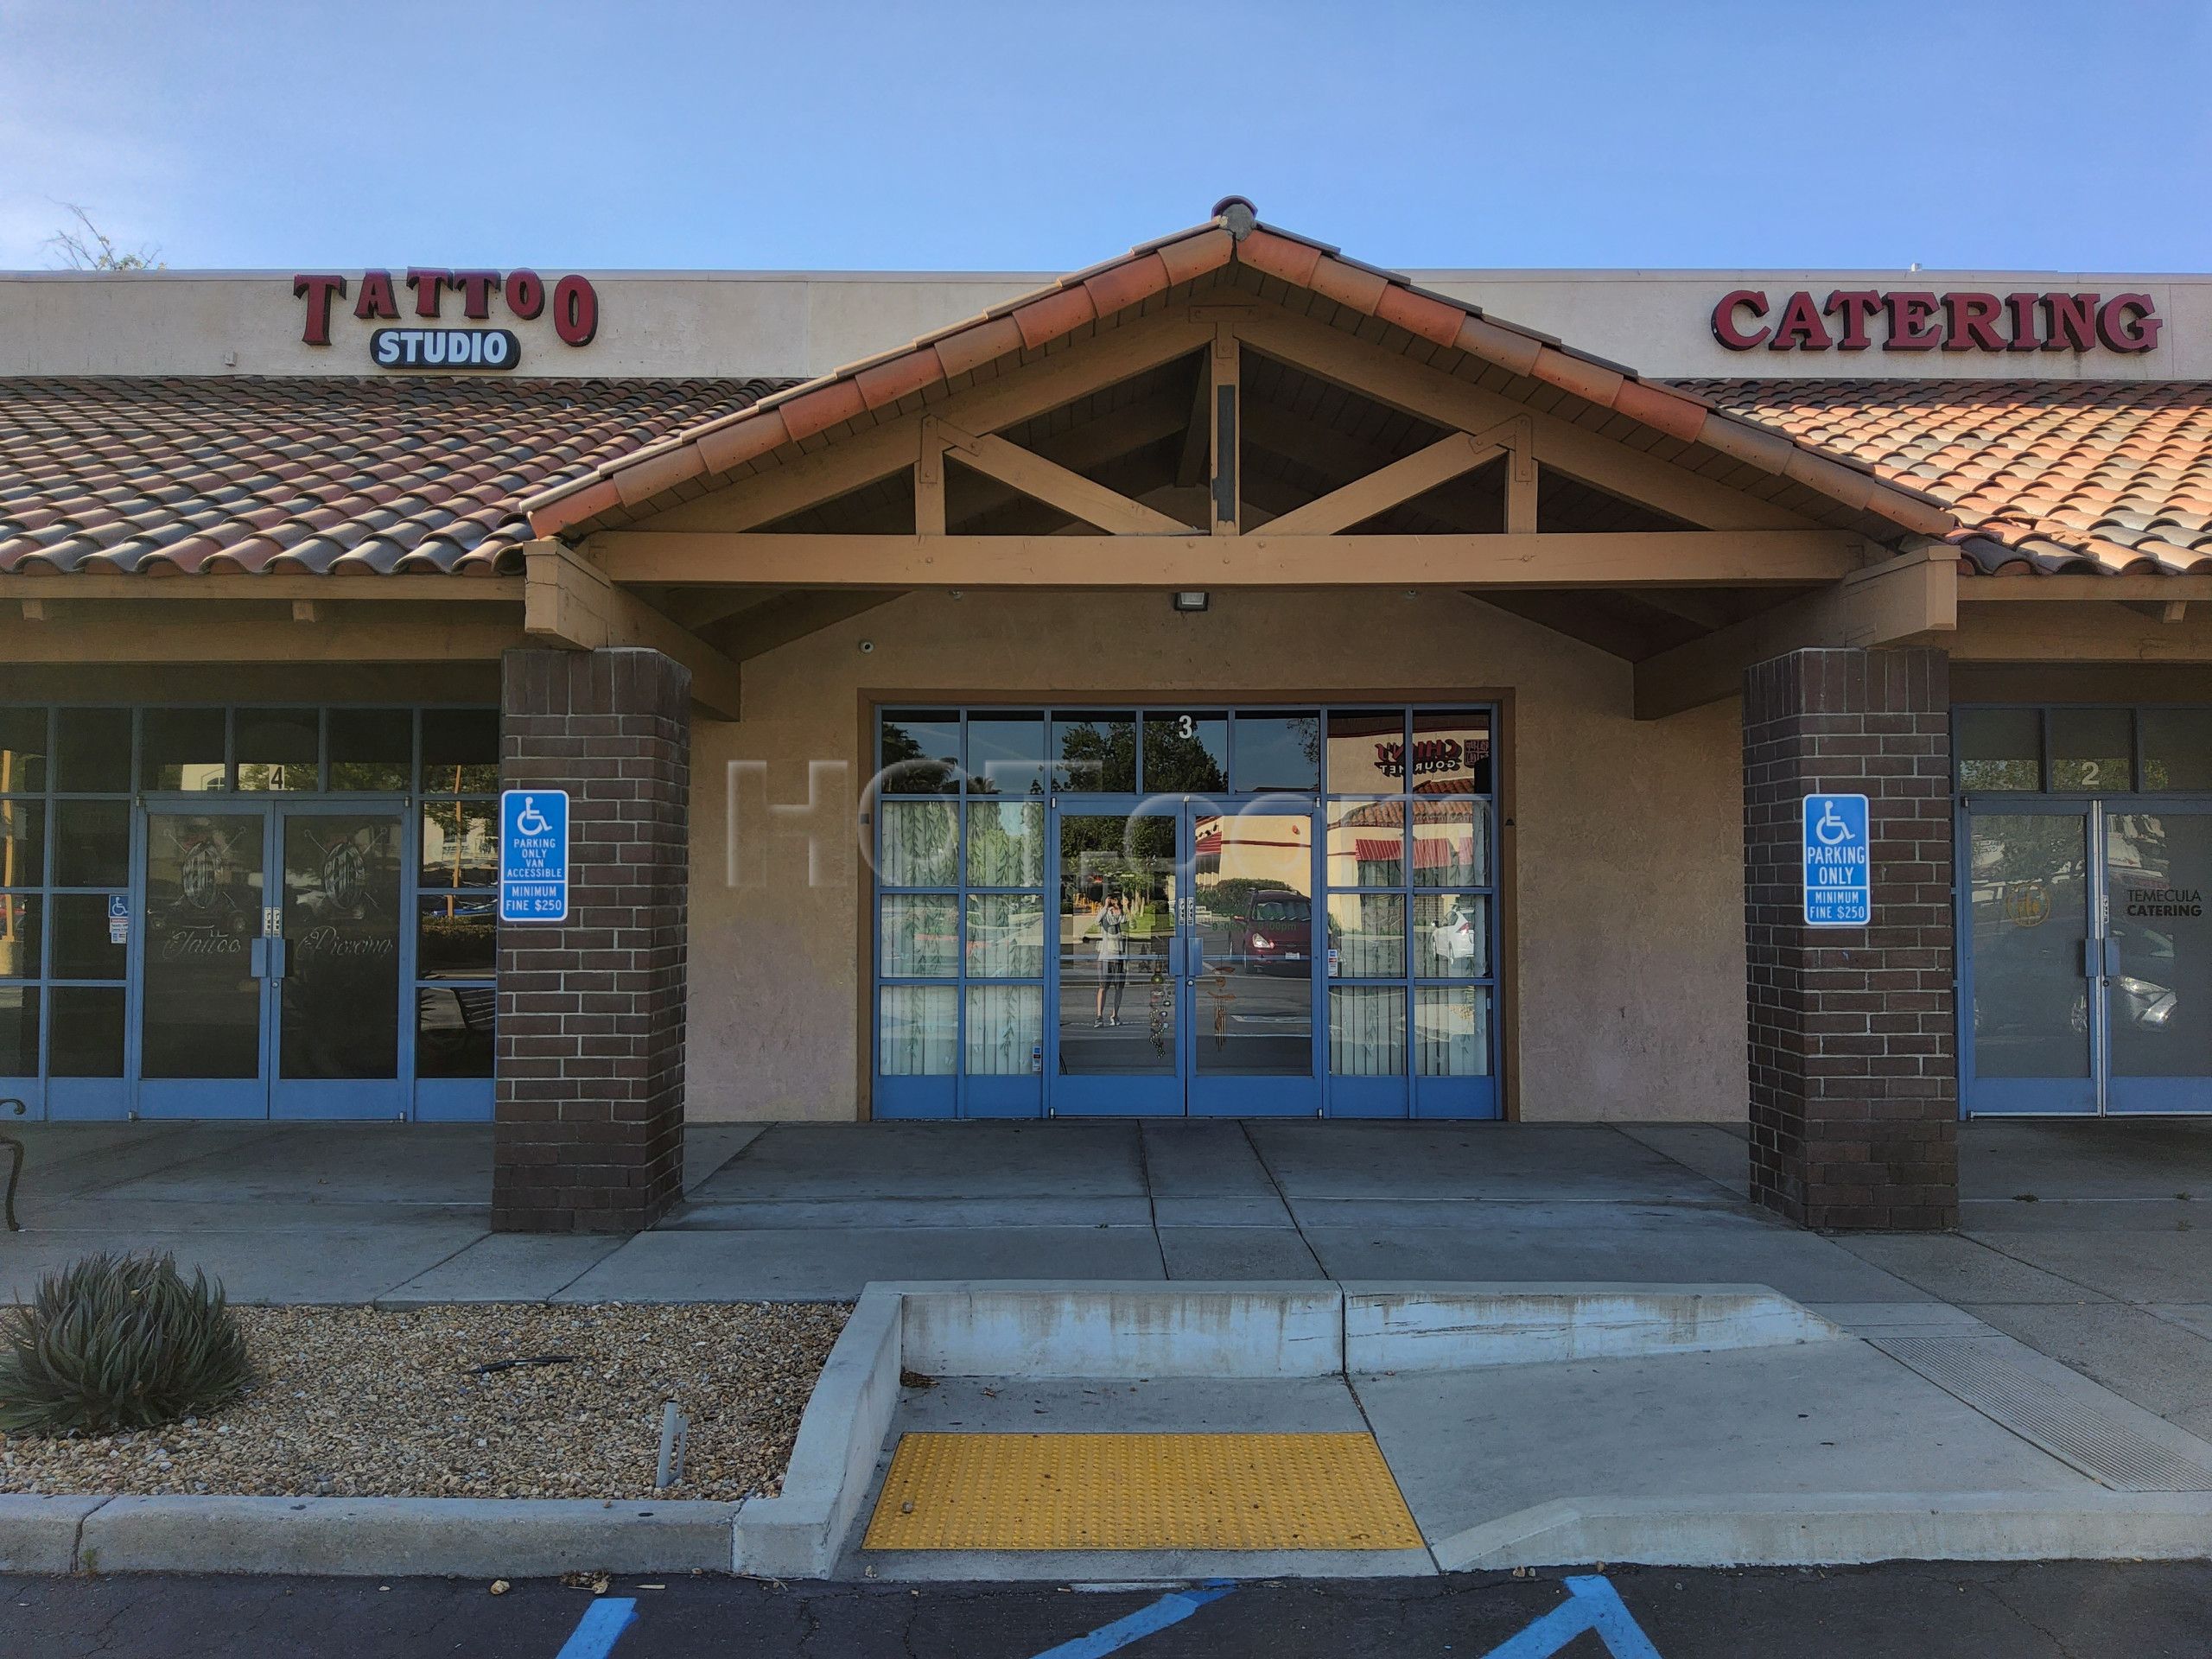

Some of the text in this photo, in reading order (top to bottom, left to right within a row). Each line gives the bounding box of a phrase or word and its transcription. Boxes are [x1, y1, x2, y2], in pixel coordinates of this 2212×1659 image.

[293, 266, 598, 346] TATTOO
[1712, 289, 2163, 353] CATERING
[378, 332, 507, 363] STUDIO
[1179, 715, 1192, 739] 3
[270, 766, 283, 790] 4
[2082, 761, 2100, 785] 2
[513, 838, 556, 848] PARKING
[522, 849, 547, 858] ONLY
[1808, 846, 1865, 864] PARKING
[525, 859, 543, 868] VAN
[506, 868, 562, 878] ACCESSIBLE
[1819, 867, 1853, 885] ONLY
[512, 886, 556, 897] MINIMUM
[1815, 891, 1859, 904] MINIMUM
[2126, 889, 2202, 902] TEMECULA
[505, 899, 562, 912] FINE $250
[1809, 906, 1865, 918] FINE $250
[2126, 905, 2202, 917] CATERING
